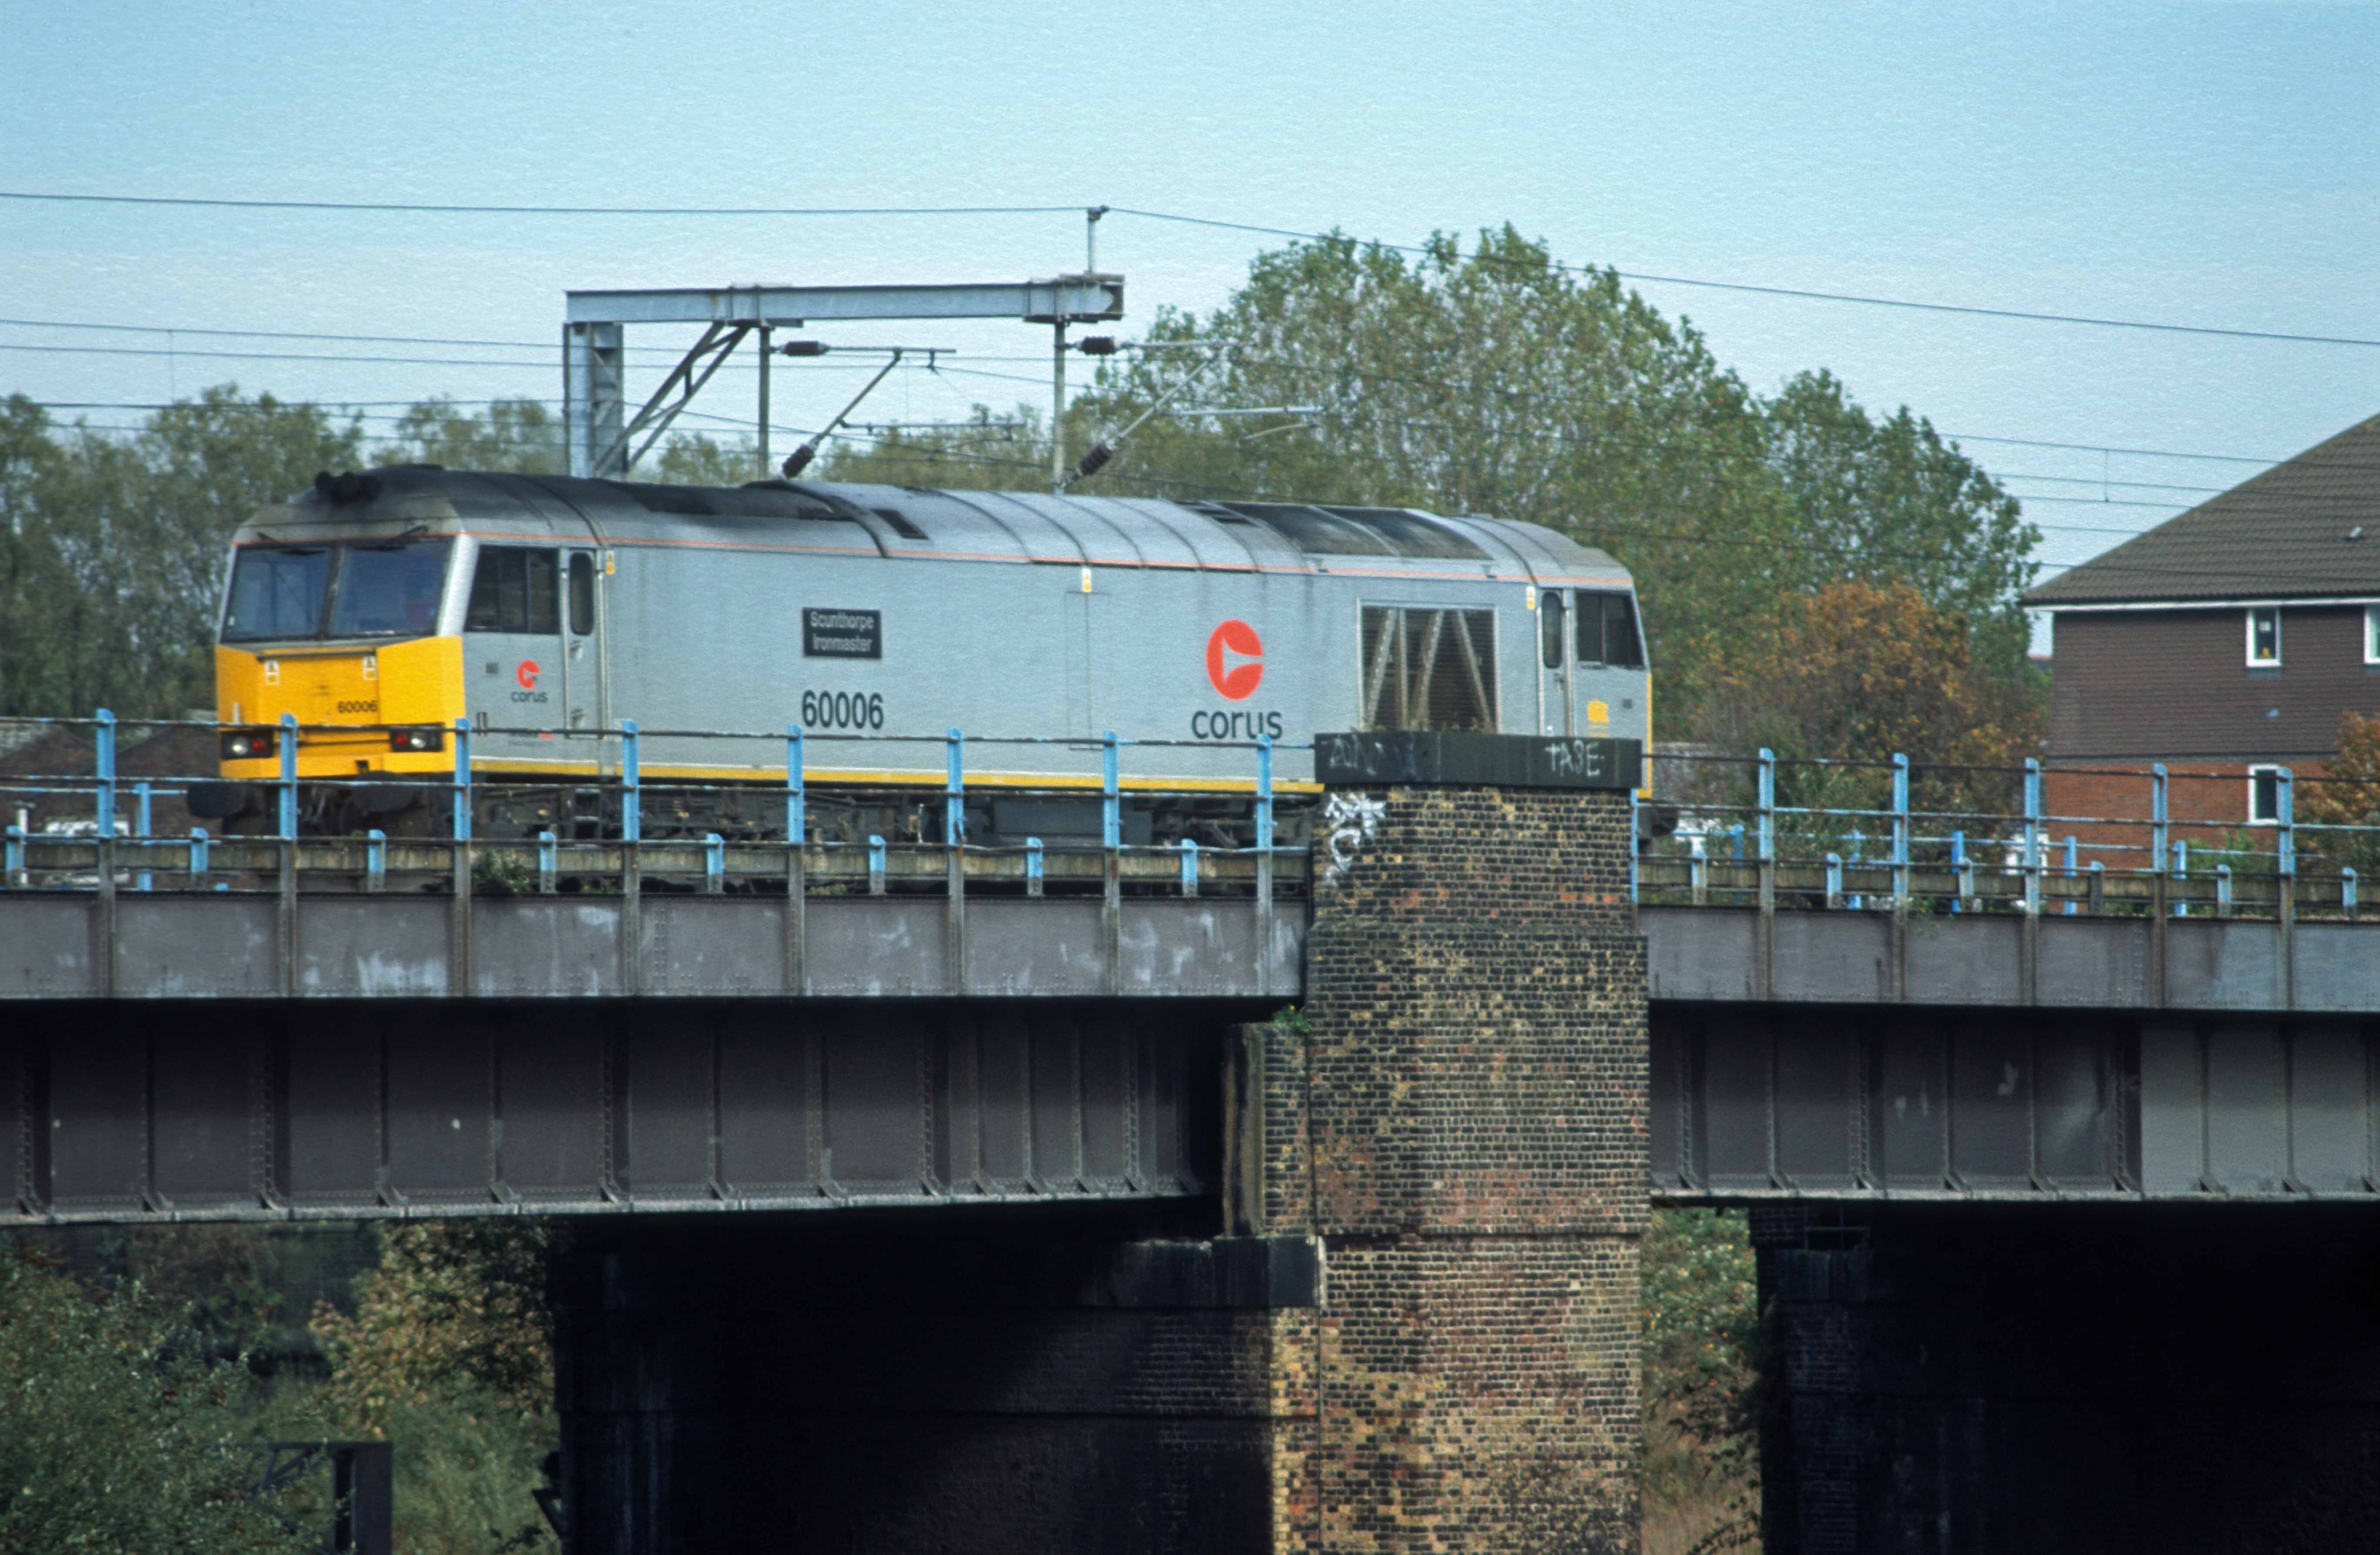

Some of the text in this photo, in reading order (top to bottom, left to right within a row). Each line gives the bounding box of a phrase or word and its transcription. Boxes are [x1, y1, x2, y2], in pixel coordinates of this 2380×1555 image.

[810, 612, 874, 630] Scunthorpe
[813, 634, 872, 651] Ironmaster
[511, 691, 548, 703] corus
[338, 700, 379, 713] 60006
[802, 690, 884, 729] 60006
[1191, 711, 1282, 740] corus
